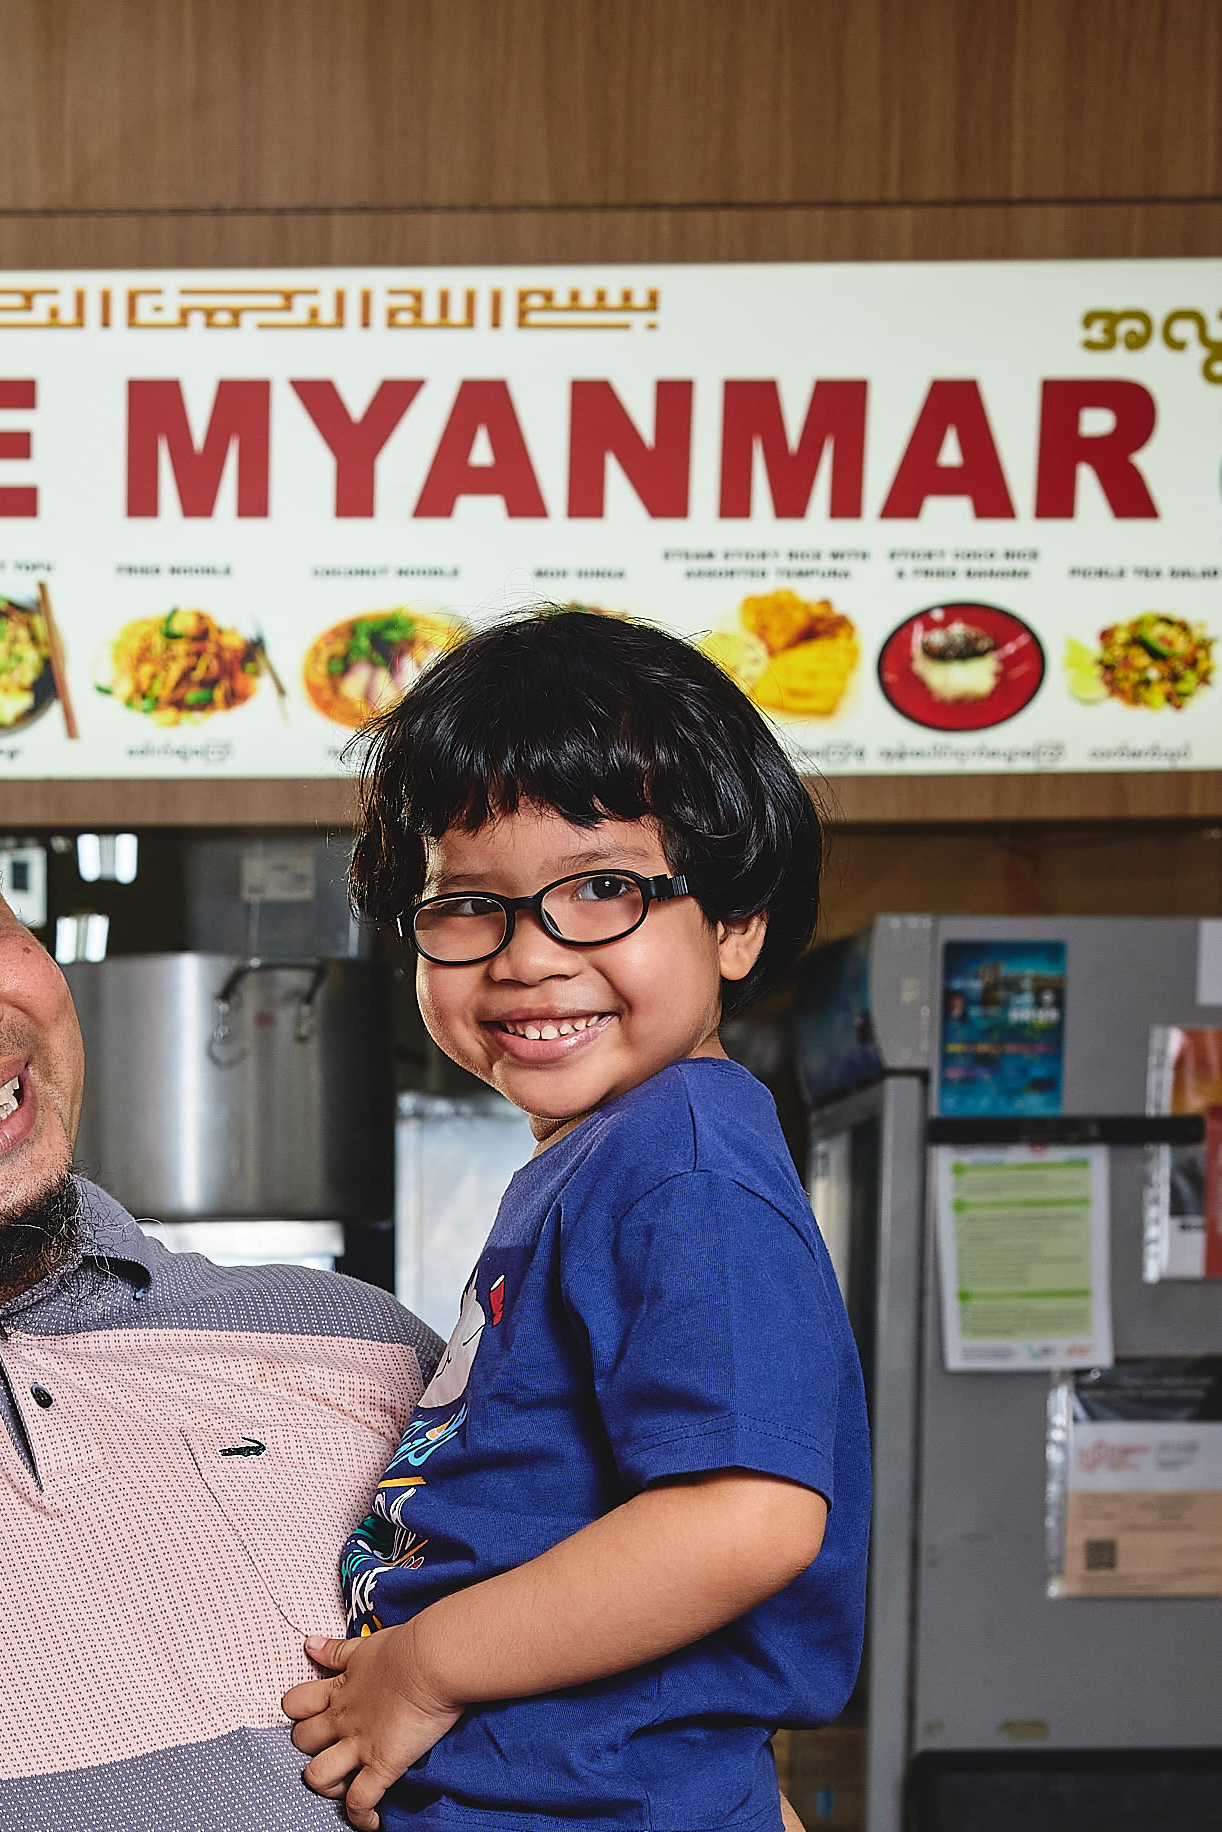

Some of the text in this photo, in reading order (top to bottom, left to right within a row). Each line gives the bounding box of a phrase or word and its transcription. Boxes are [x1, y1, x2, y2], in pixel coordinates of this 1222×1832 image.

[125, 376, 1162, 521] MYANMAR
[786, 548, 822, 562] RICE
[1002, 548, 1040, 561] RICE
[115, 563, 232, 577] FRIED NOODLE
[313, 565, 460, 579] COCONUT NOODLE
